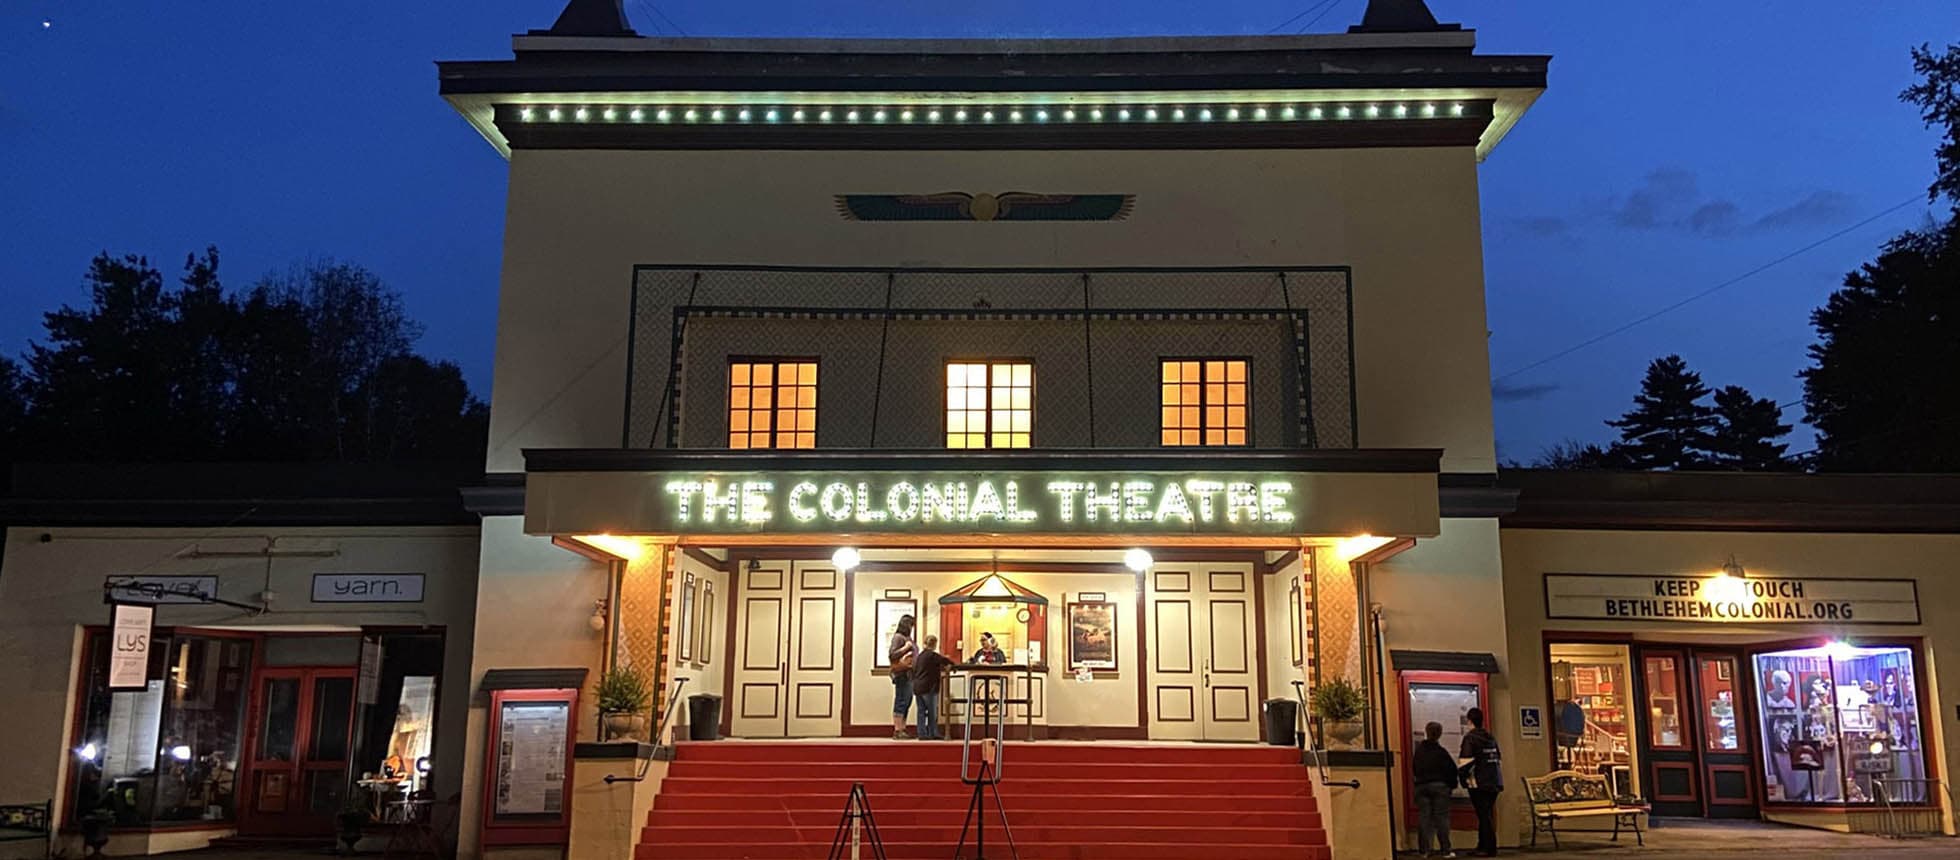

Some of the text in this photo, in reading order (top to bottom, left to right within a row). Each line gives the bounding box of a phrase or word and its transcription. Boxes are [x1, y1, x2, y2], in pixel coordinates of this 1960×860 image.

[665, 480, 1295, 522] THE COLONIAL THEATRE
[334, 580, 403, 595] yarn.
[1654, 580, 1804, 599] KEEP TOUCH
[1606, 600, 1853, 620] BETHLEHEMCOLONIAL.ORG
